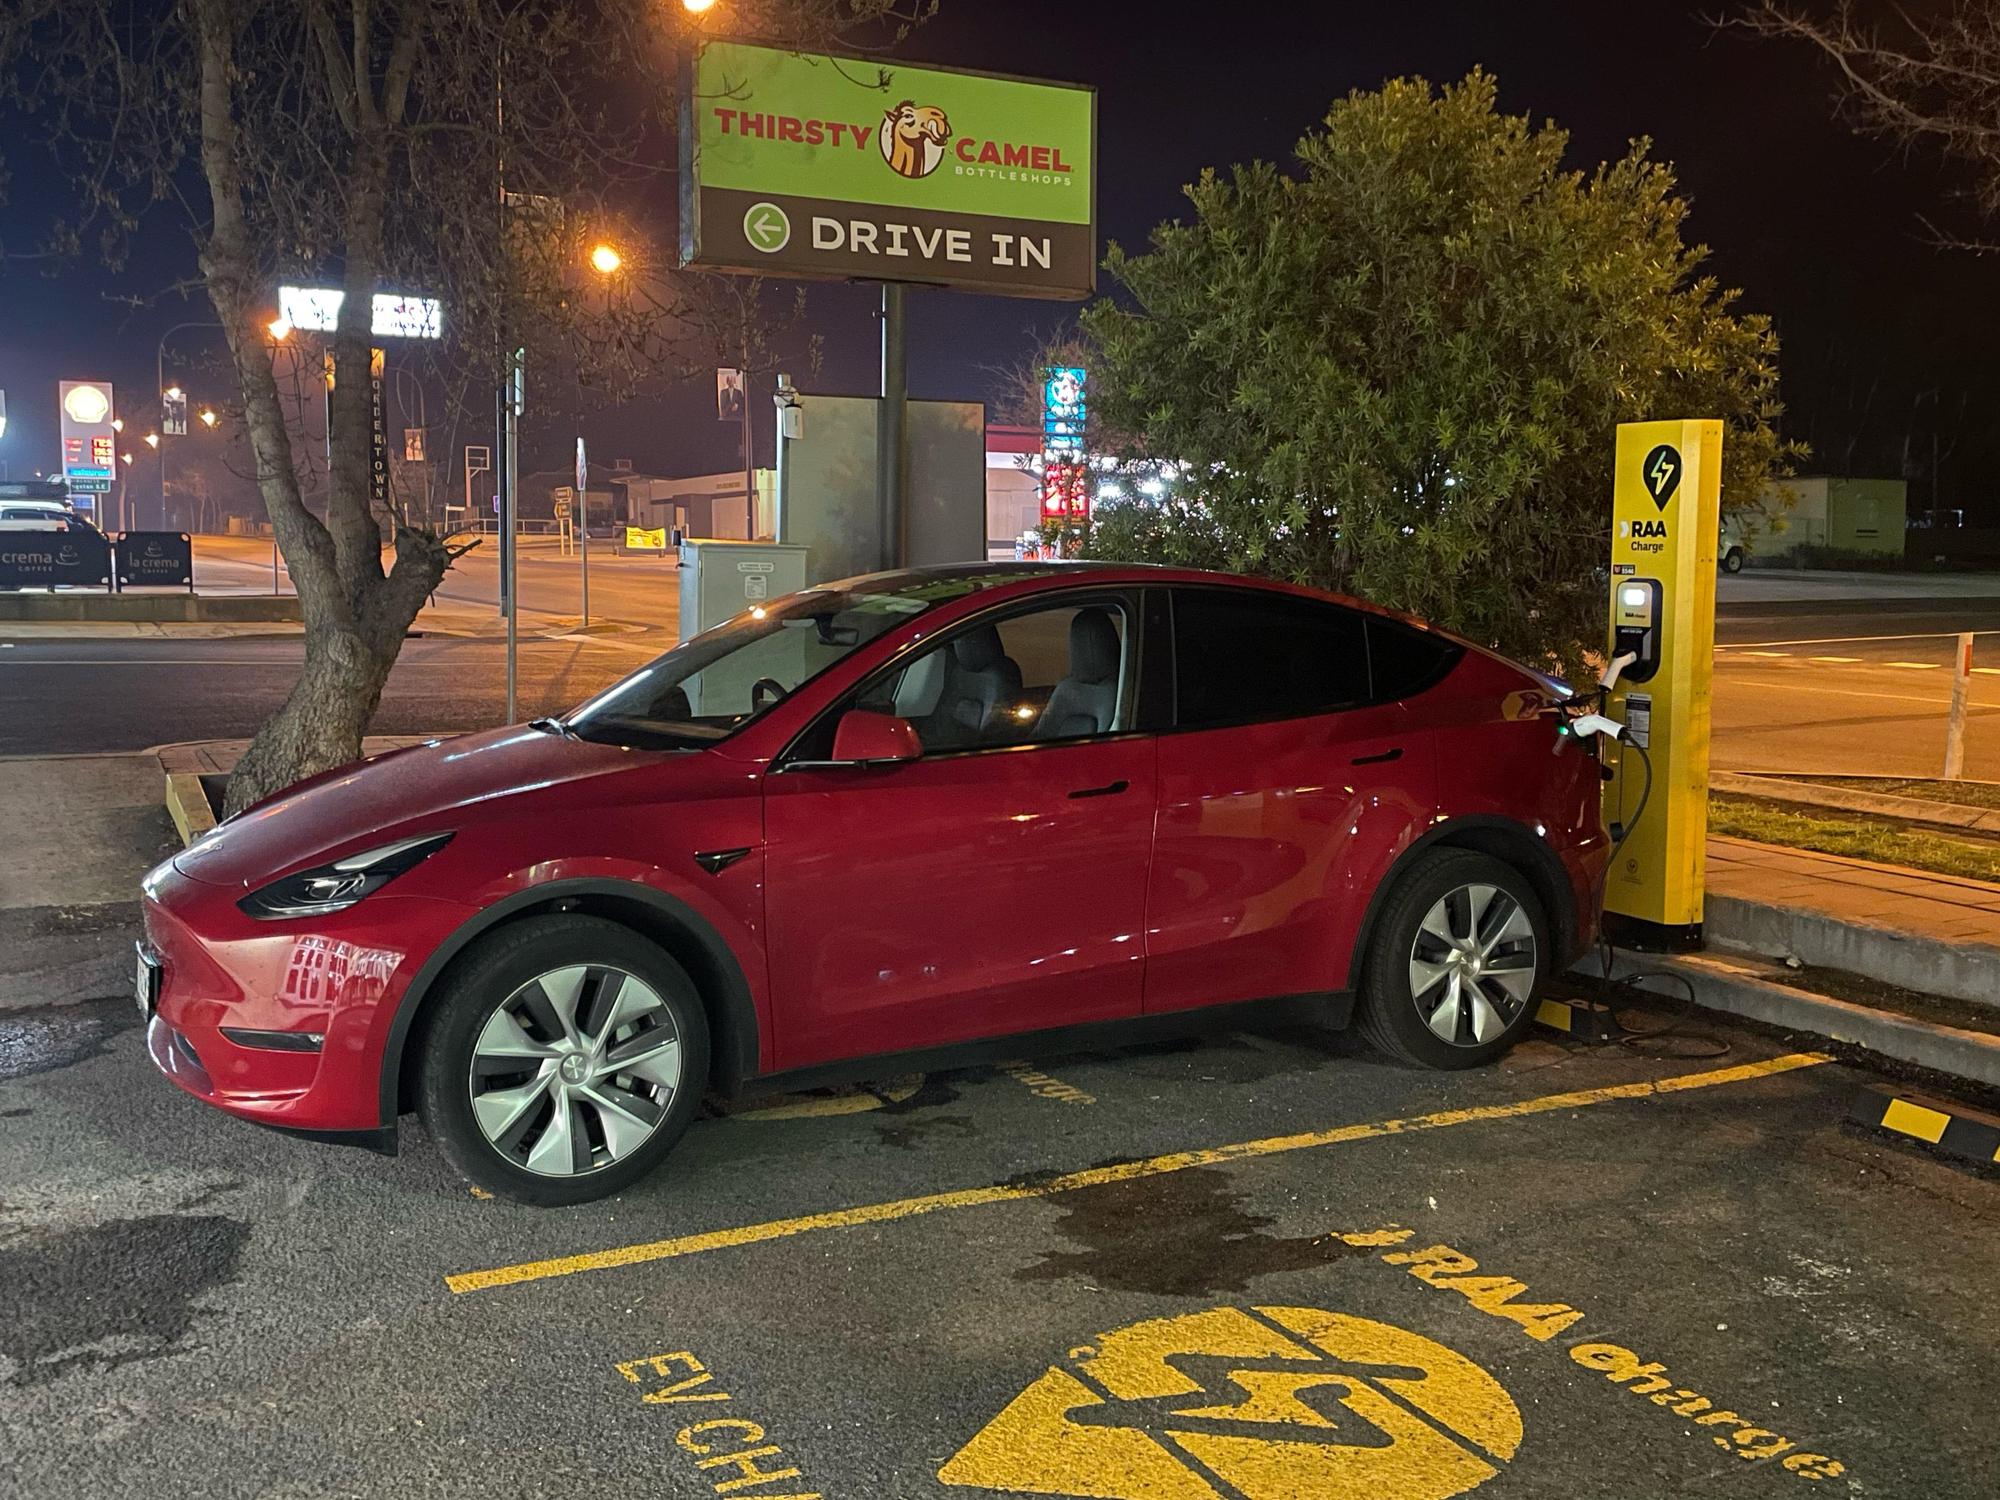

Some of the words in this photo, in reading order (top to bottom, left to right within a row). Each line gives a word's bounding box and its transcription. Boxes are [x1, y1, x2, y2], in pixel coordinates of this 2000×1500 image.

[714, 107, 873, 150] THIRSTY
[955, 138, 1071, 173] CAMEL
[955, 166, 1071, 186] BOTTLESHOPS
[812, 216, 972, 262] DRIVE
[992, 234, 1051, 269] IN
[1631, 520, 1667, 538] RAA
[1630, 541, 1664, 554] Charge
[1, 552, 52, 564] crema
[129, 552, 140, 567] la
[142, 558, 180, 569] crema
[1381, 1244, 1586, 1343] RAA
[614, 1351, 732, 1404] EV
[675, 1418, 825, 1500] CH
